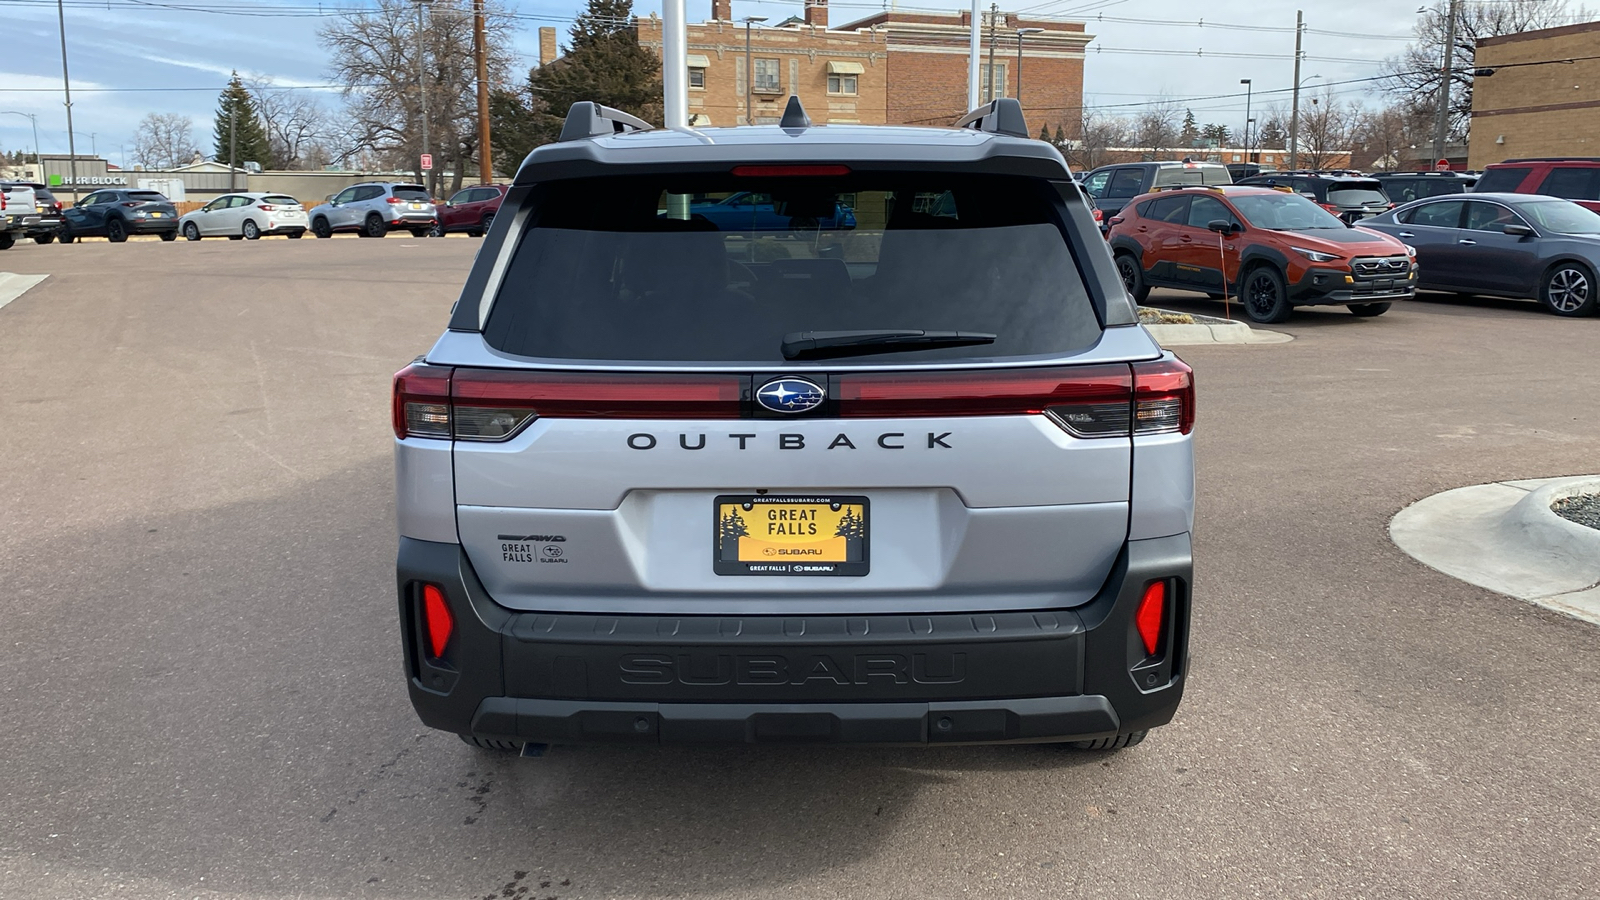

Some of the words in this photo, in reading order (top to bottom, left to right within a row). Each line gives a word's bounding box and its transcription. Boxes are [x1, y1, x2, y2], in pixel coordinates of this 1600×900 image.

[91, 176, 128, 185] BLOCK
[626, 432, 953, 451] OUTBACK
[767, 509, 817, 521] GREAT
[767, 522, 817, 535] FALLS
[522, 534, 567, 542] AWD
[501, 543, 531, 552] GREAT
[502, 552, 533, 562] FALLS
[618, 652, 967, 685] SUBARU
